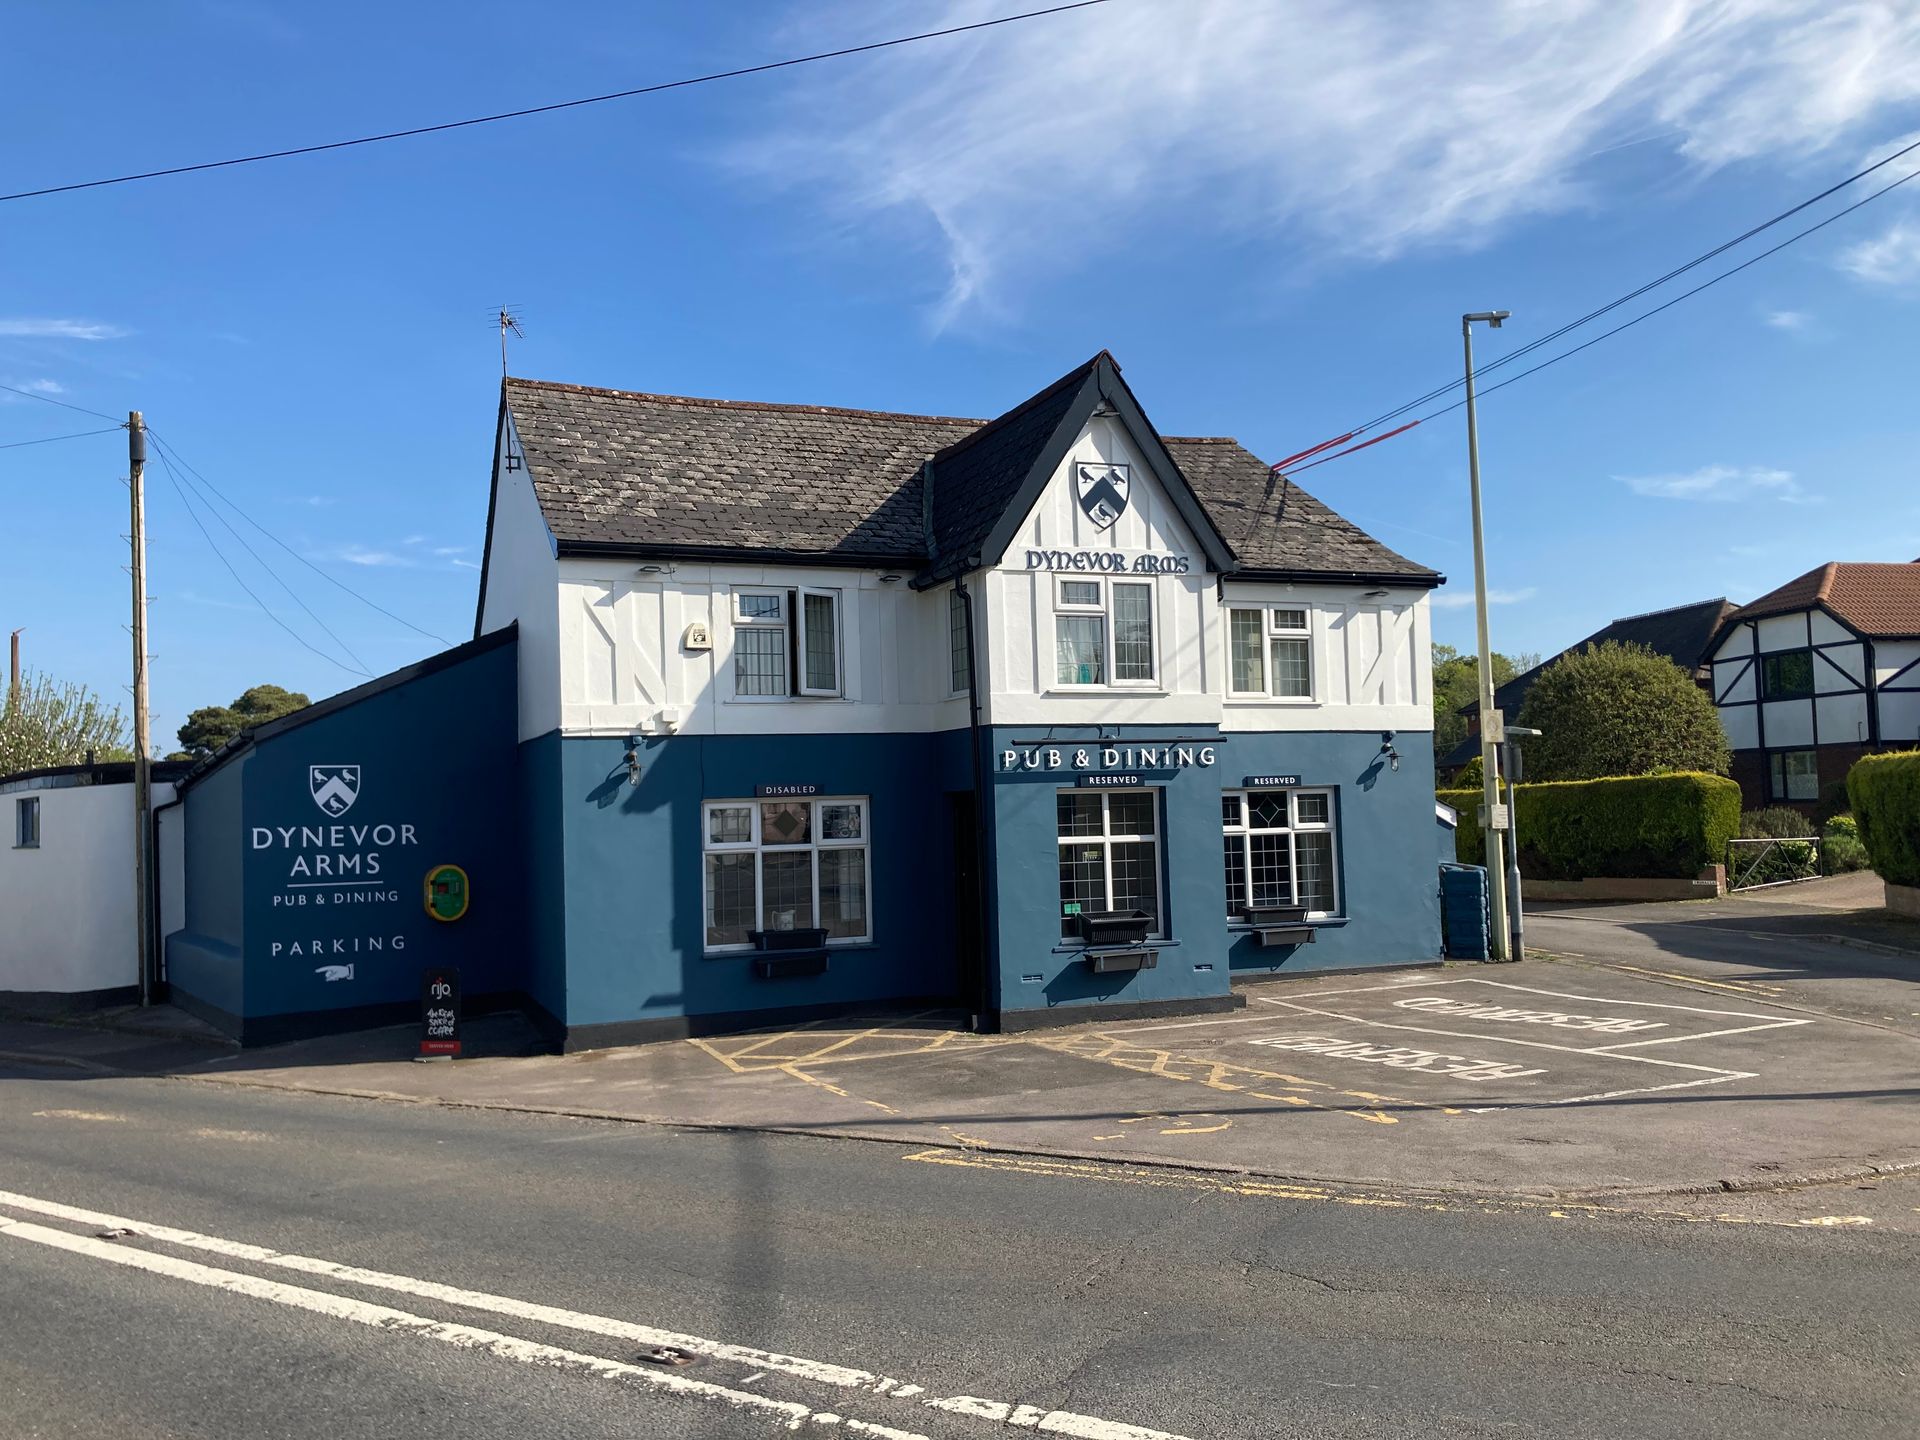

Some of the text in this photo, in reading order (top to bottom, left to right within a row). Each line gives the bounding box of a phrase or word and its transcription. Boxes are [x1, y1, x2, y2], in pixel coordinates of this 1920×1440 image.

[1025, 550, 1190, 574] DYNEVOR ARMS
[1005, 747, 1215, 768] PUB & DINING
[765, 785, 816, 794] DISABLED
[1089, 776, 1138, 785] RESERVED
[1254, 777, 1296, 785] RESERVED
[252, 824, 418, 849] DYNEVOR
[290, 853, 380, 877] ARMS
[273, 890, 399, 906] PUB & DINING
[272, 935, 406, 956] PARKING
[1393, 998, 1669, 1033] RESERVED
[1248, 1036, 1549, 1081] RESERVED
